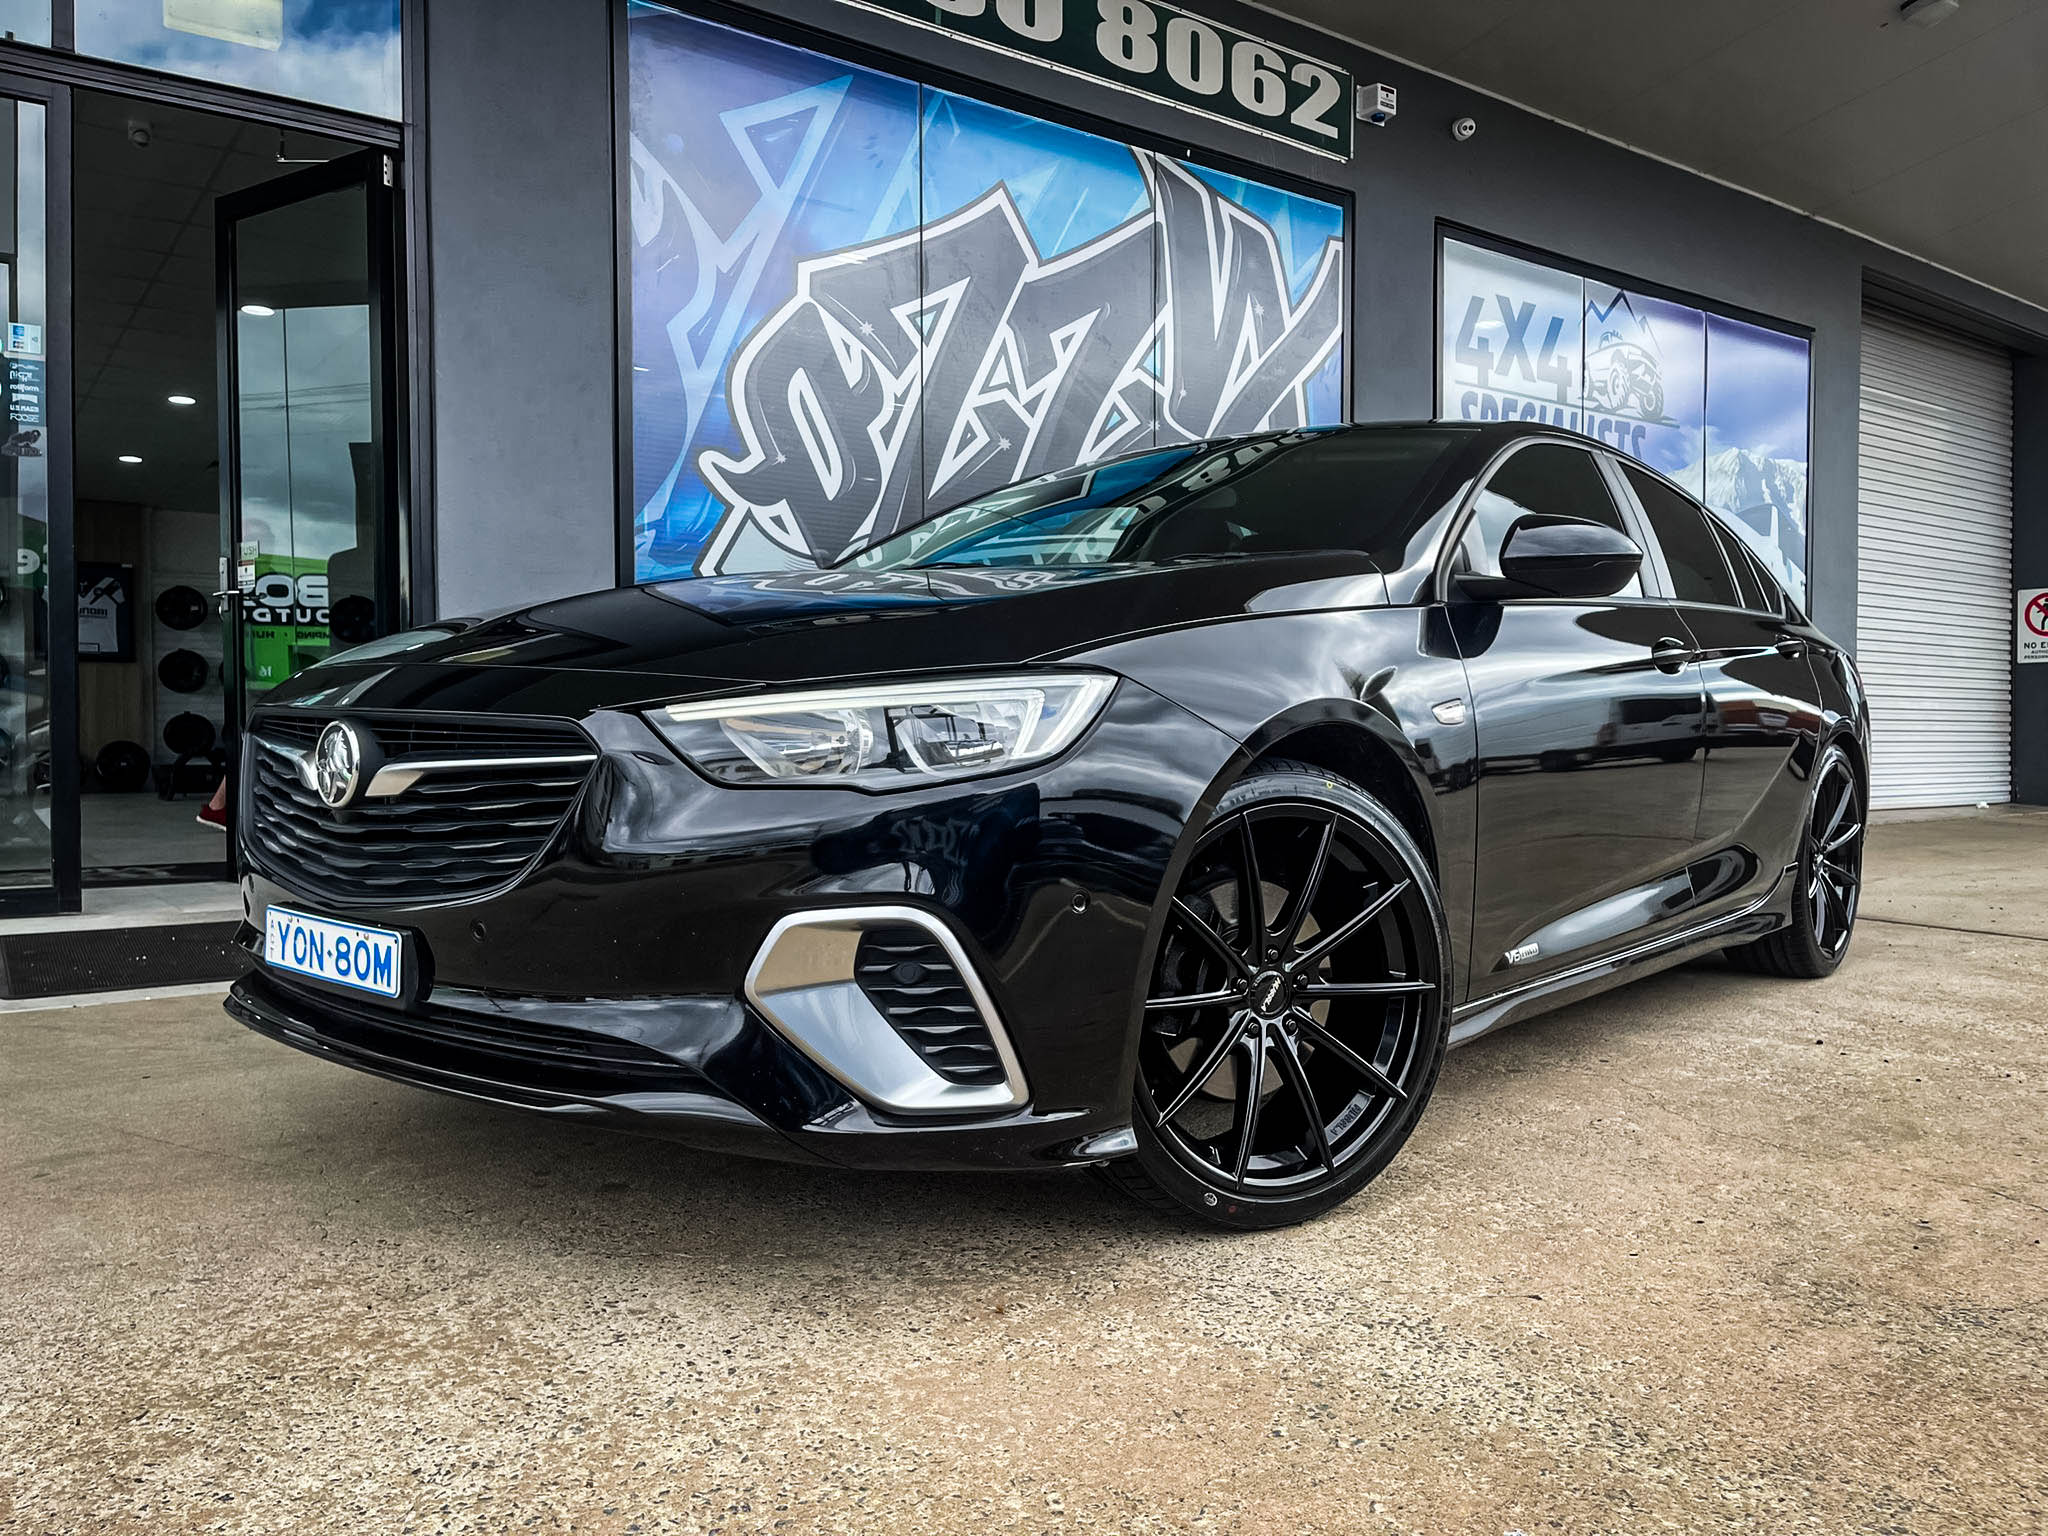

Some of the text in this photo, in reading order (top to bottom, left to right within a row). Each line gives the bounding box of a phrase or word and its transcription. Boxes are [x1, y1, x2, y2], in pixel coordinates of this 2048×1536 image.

[1096, 0, 1342, 141] 8062
[1455, 294, 1574, 402] 4X4
[2024, 642, 2037, 650] NO
